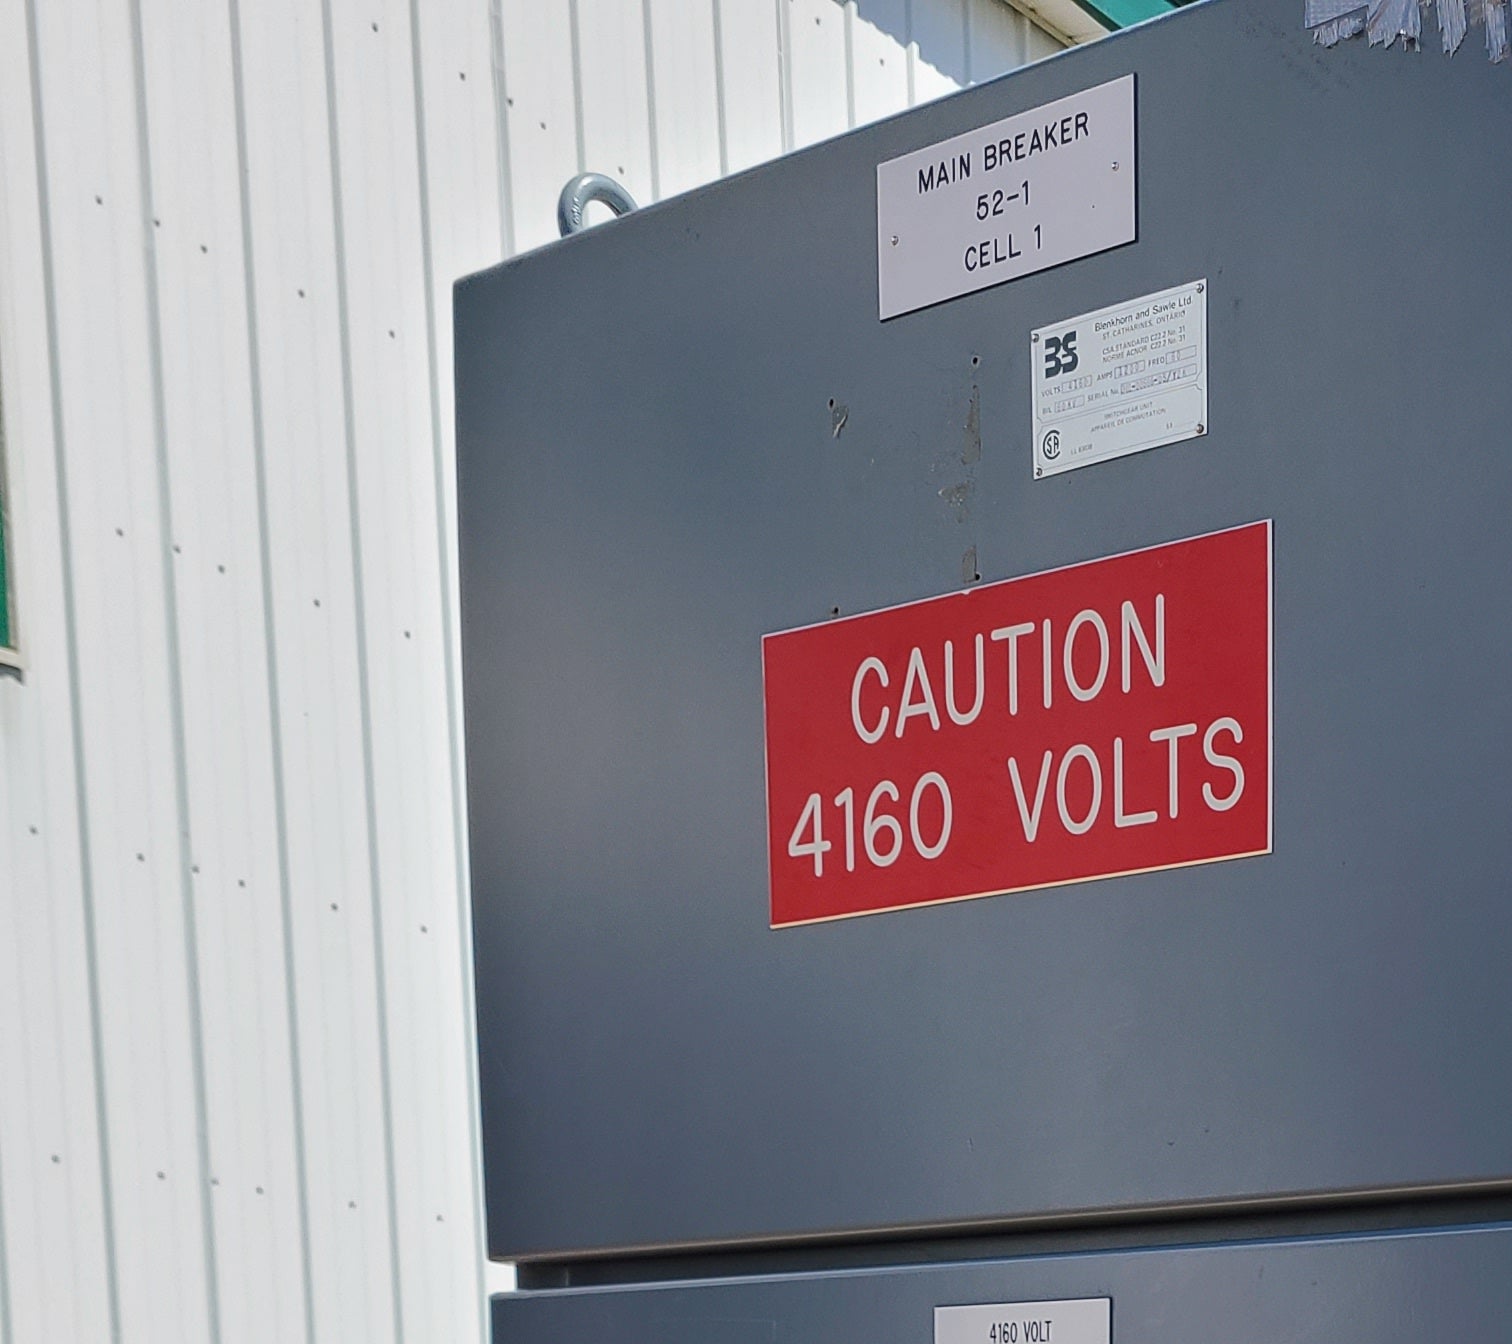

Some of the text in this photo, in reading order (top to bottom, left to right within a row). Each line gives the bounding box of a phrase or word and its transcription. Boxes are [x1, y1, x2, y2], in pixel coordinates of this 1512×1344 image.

[918, 112, 1089, 194] MAIN BREAKER
[976, 180, 1029, 221] 52-1
[964, 224, 1042, 272] CELL 1
[1094, 315, 1133, 332] Blenkhorn
[1135, 307, 1149, 319] and
[1152, 299, 1175, 315] Sawle
[1156, 309, 1185, 324] ONTARIO
[1115, 336, 1148, 351] STANDARD
[1041, 386, 1060, 397] VOLTS
[1097, 371, 1112, 381] AMPS
[851, 593, 1165, 744] CAUTION
[788, 716, 1246, 877] 4160 VOLTS
[989, 1320, 1052, 1344] 4160 VOLT
